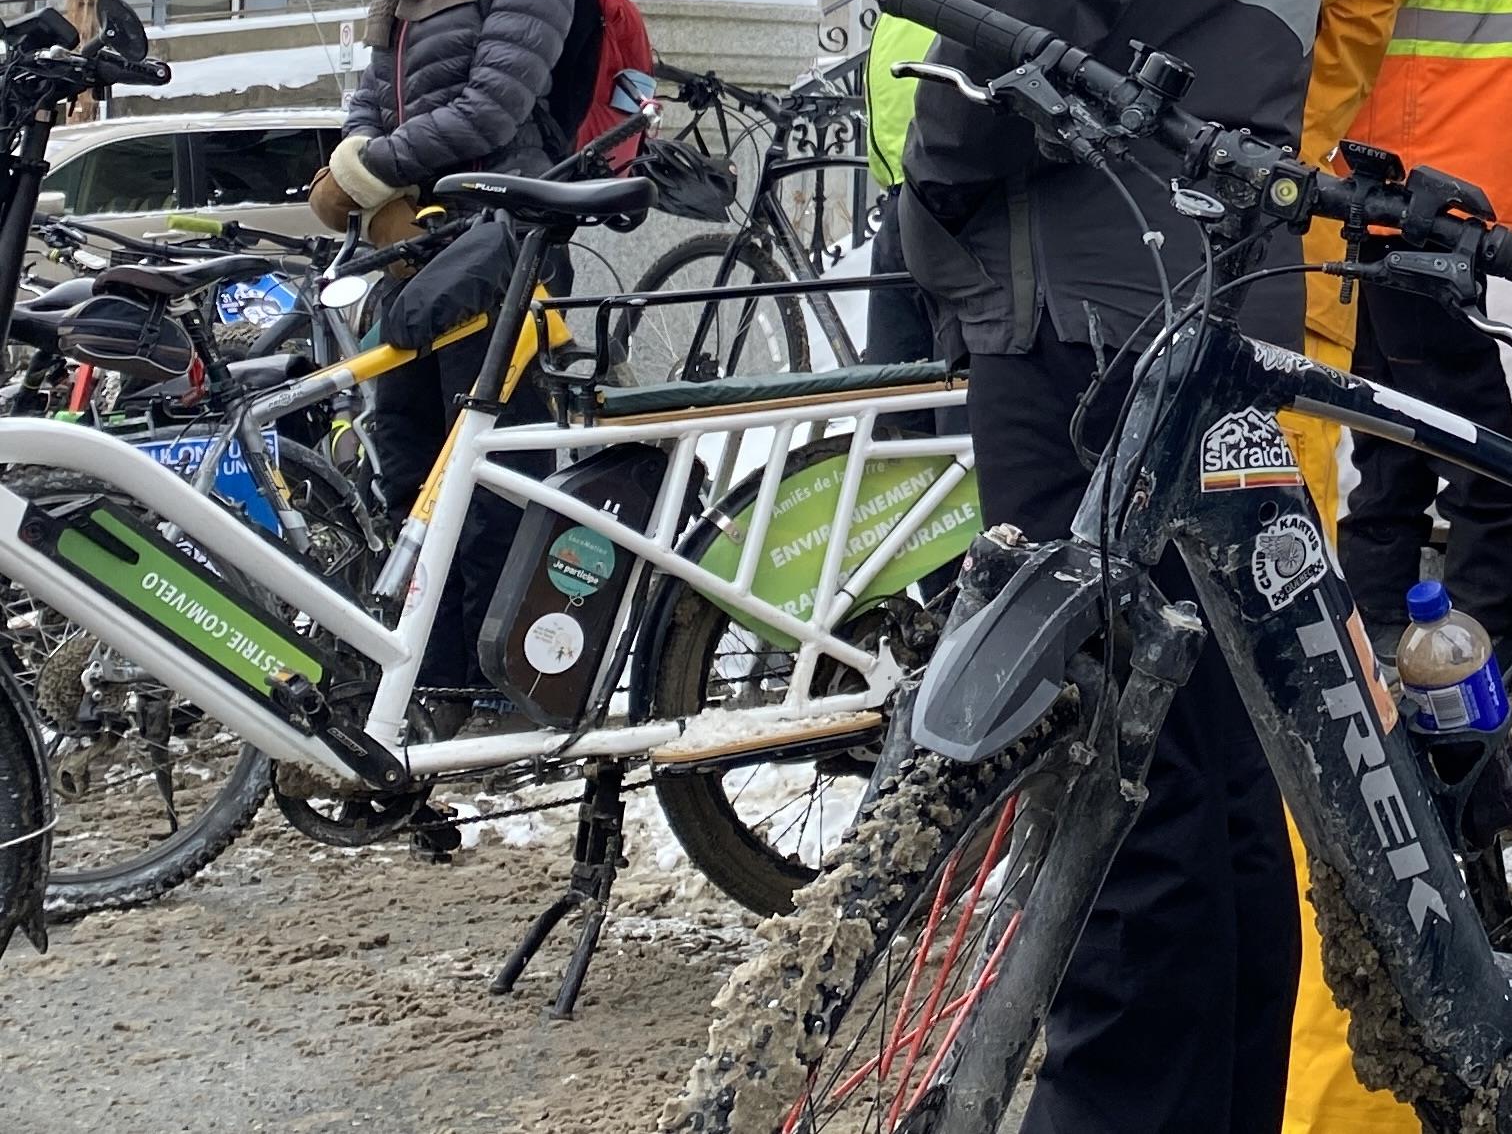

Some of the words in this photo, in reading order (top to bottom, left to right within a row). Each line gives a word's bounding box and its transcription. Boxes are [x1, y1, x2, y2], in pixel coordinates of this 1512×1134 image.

[1348, 143, 1387, 160] CATEYE
[1205, 440, 1294, 472] skratch
[814, 476, 832, 492] de
[769, 467, 936, 568] ENVIRNNEMENT
[1255, 550, 1272, 590] CLUB
[1279, 517, 1320, 552] KARTUS
[1296, 588, 1452, 936] TREK
